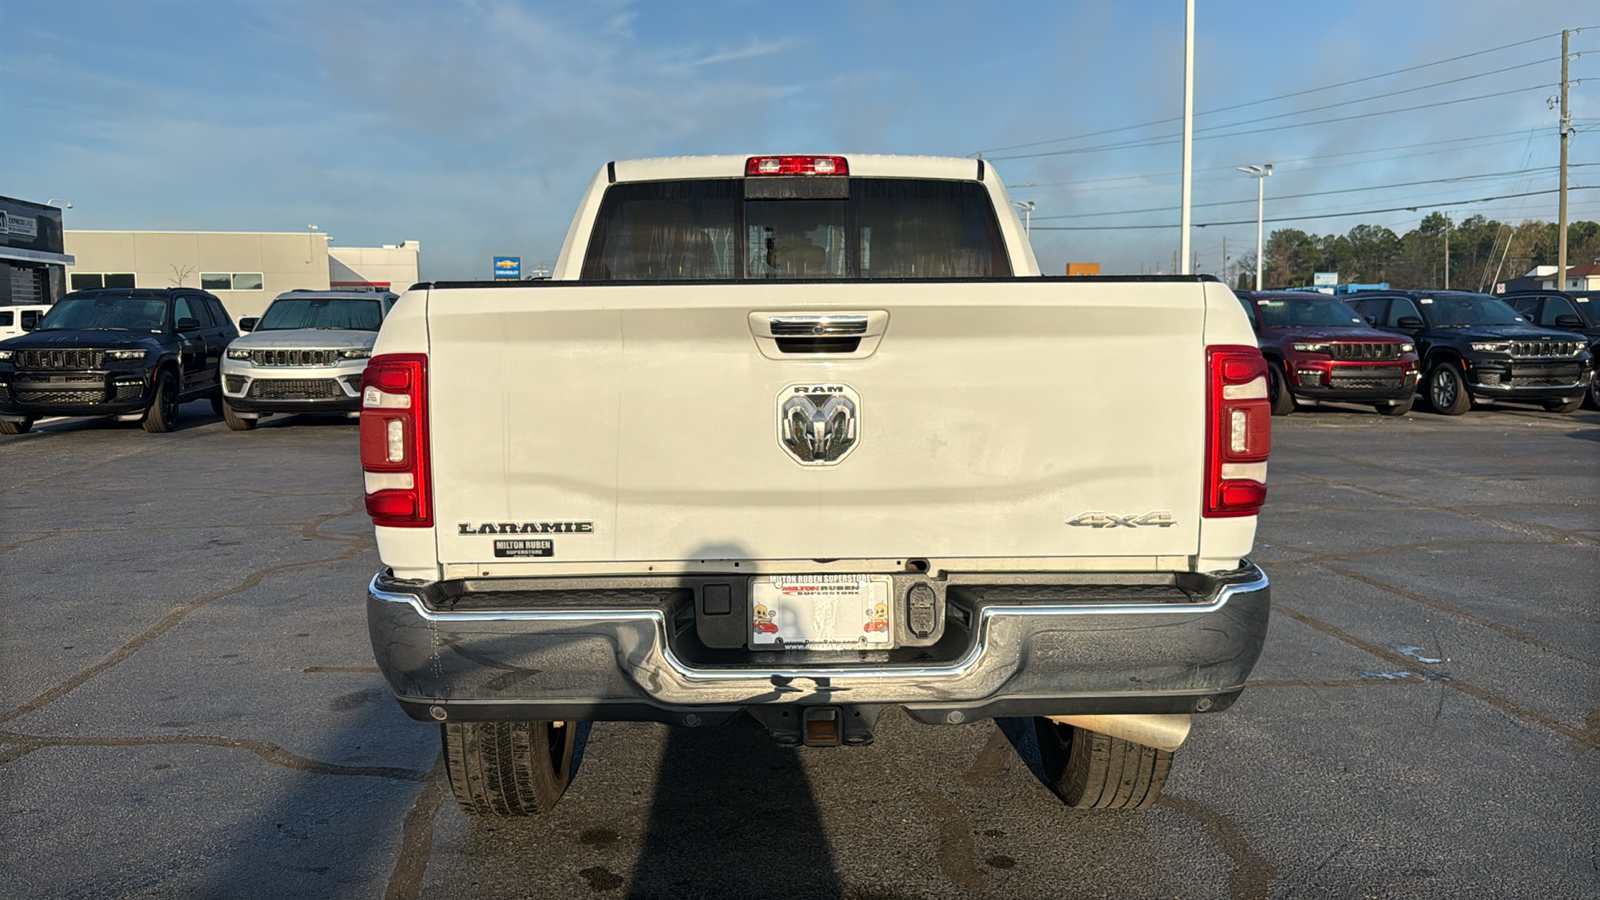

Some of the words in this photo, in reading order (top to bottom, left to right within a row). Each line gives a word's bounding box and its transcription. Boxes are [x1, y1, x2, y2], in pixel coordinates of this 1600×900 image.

[459, 522, 593, 534] LARAMIE
[496, 541, 524, 549] MILTON
[525, 541, 550, 549] RUBEN
[798, 575, 823, 583] RUBEN
[823, 574, 871, 583] SUPERSTORE
